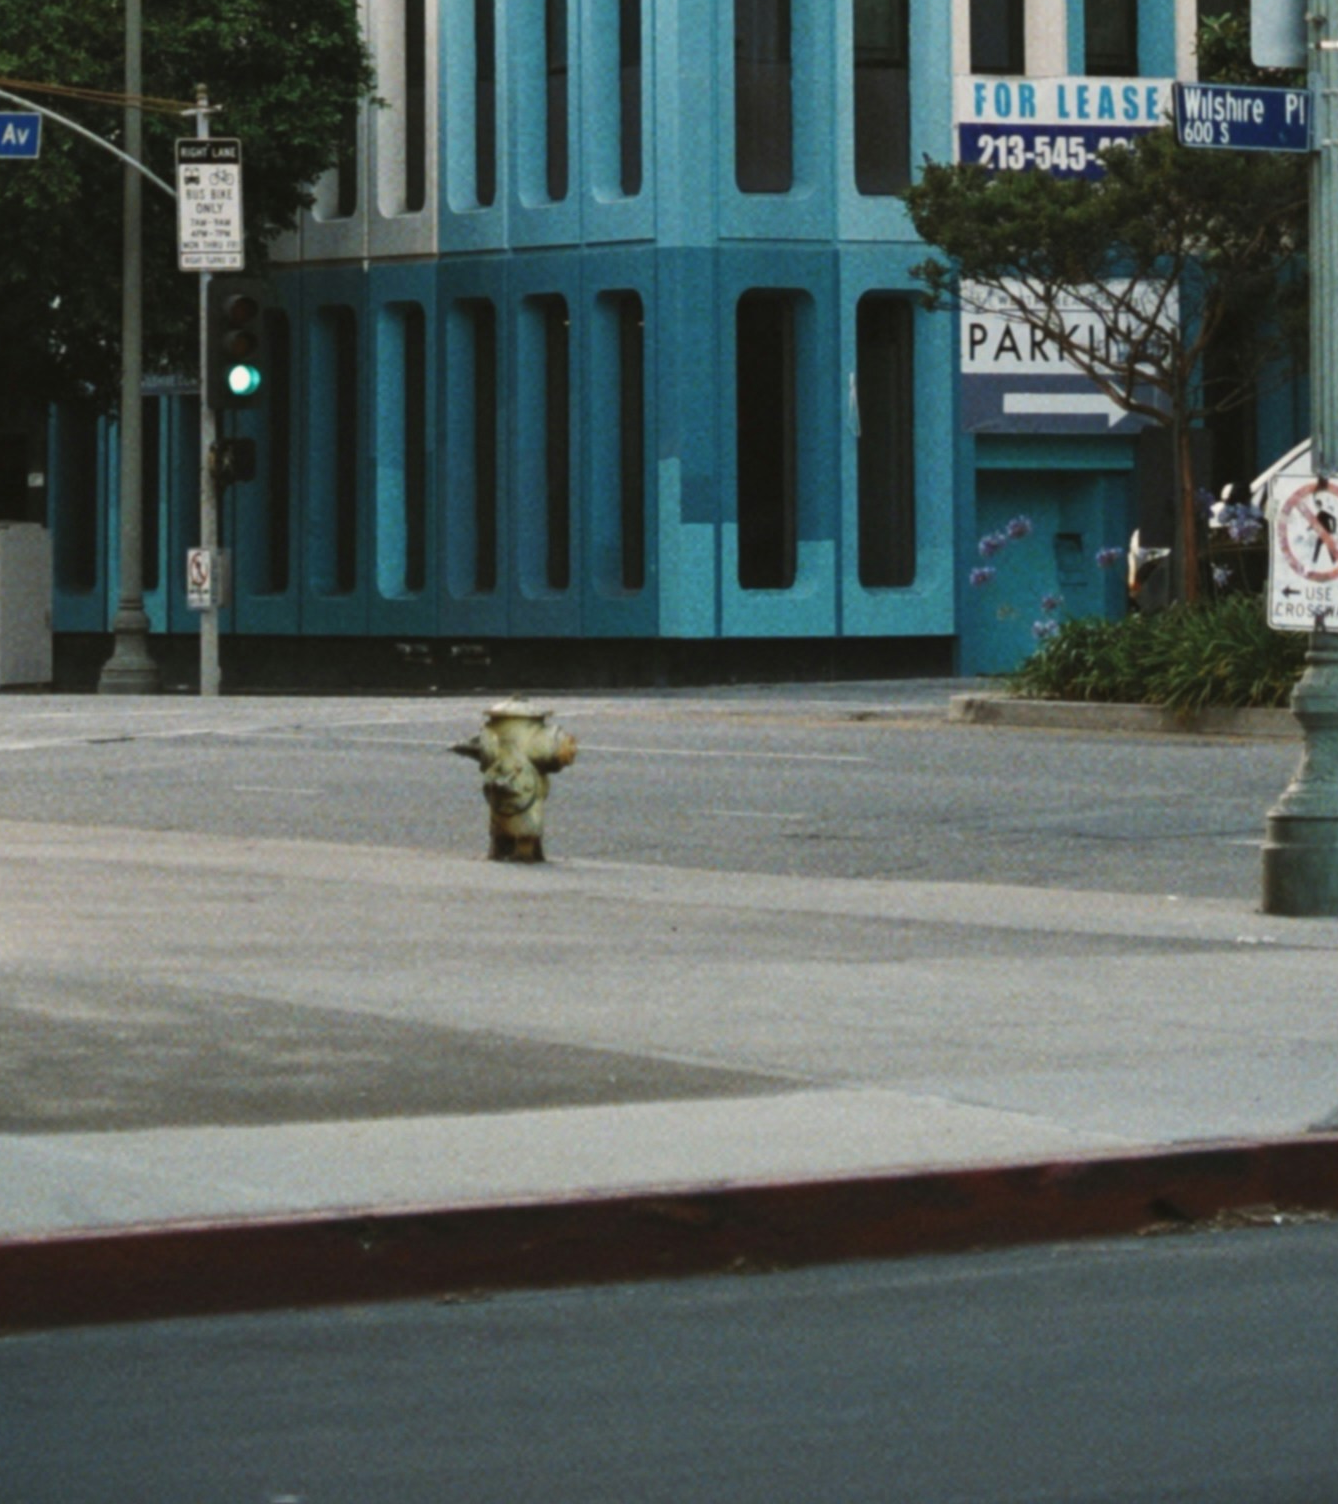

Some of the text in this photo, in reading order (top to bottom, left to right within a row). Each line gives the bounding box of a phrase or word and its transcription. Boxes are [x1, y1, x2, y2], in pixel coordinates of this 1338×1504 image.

[973, 82, 1160, 121] FOR LEASE
[1183, 88, 1305, 125] Wilshire Pl
[1, 123, 30, 145] Av
[1183, 121, 1230, 144] 600 S
[212, 146, 235, 158] LANE
[978, 134, 1136, 171] 213-545-
[196, 202, 223, 214] ONLY
[1305, 586, 1333, 602] USE
